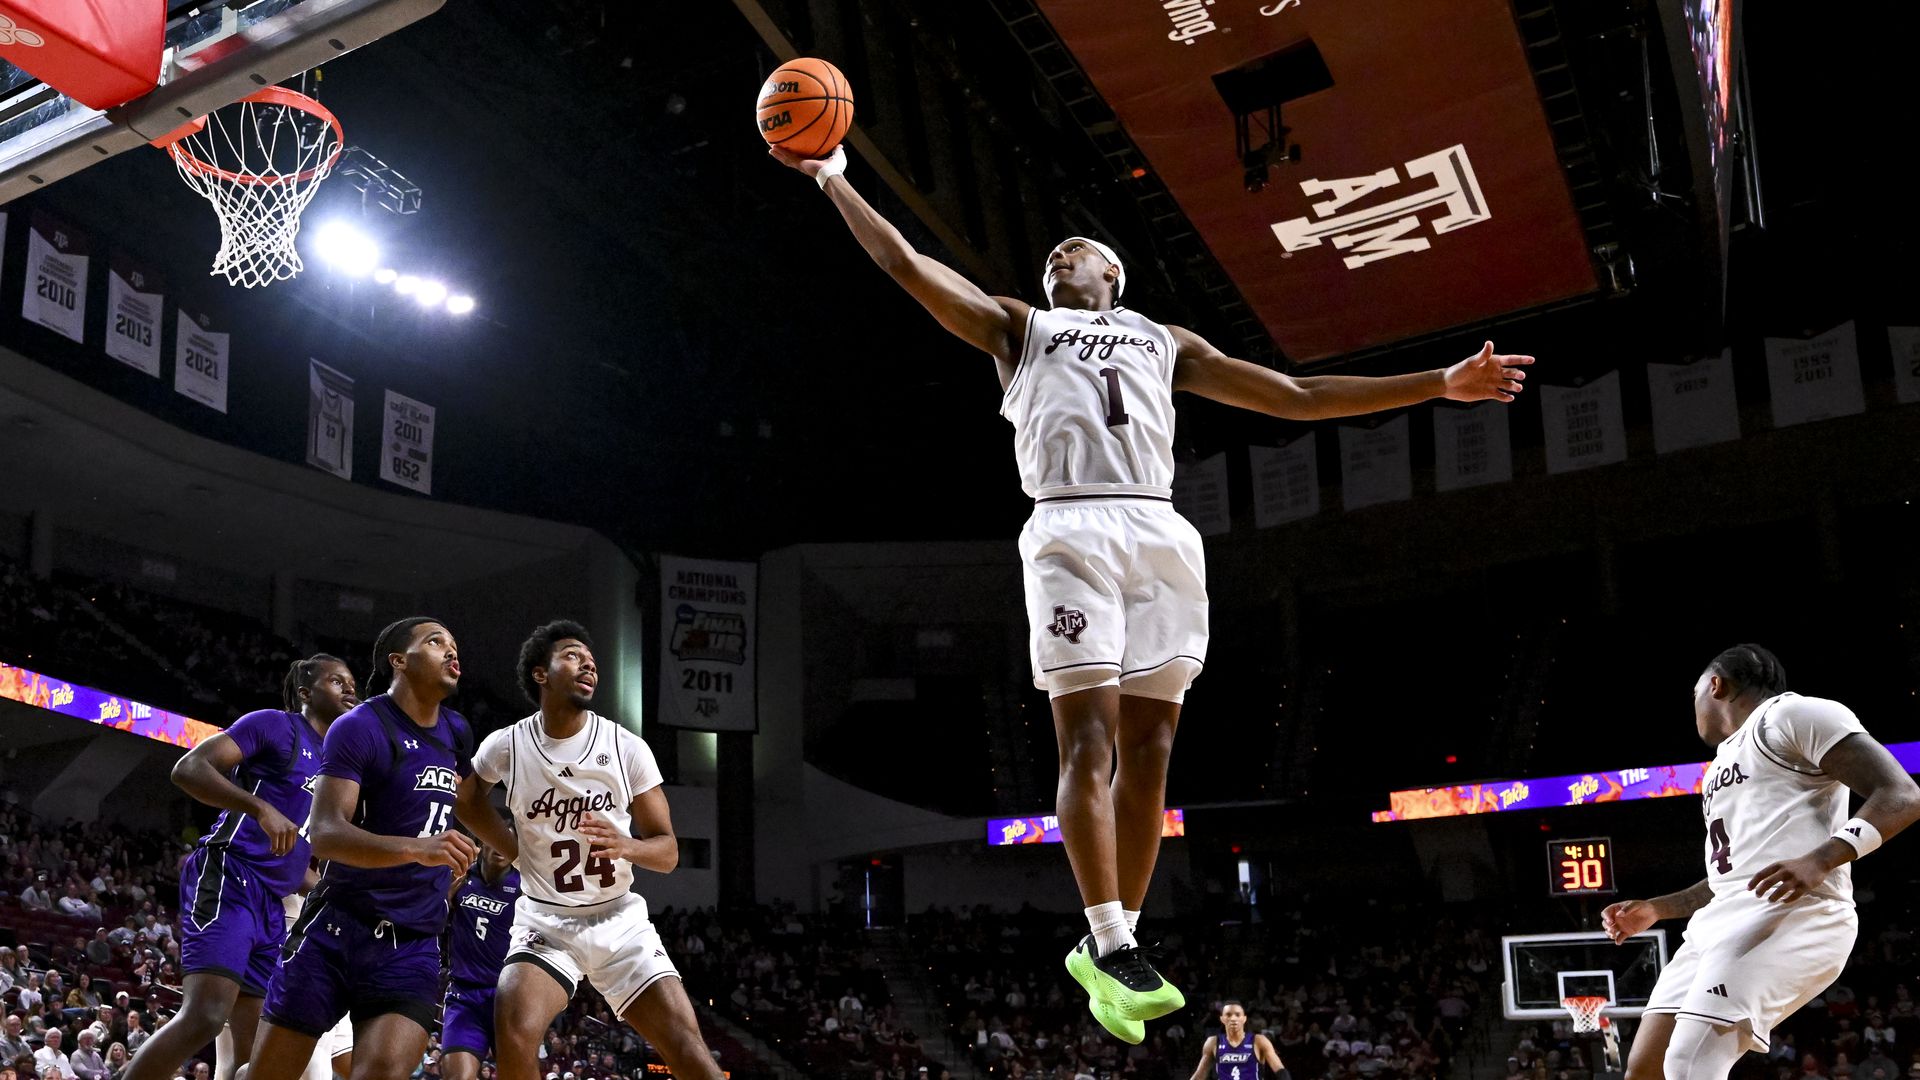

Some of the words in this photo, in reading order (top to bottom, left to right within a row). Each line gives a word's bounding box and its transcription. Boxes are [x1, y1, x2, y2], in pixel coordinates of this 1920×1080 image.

[760, 110, 792, 132] NCAA
[37, 275, 75, 310] 2010
[115, 314, 152, 347] 2013
[1045, 329, 1159, 361] Aggies
[185, 348, 219, 380] 2021
[1100, 368, 1129, 427] 1
[394, 420, 423, 445] 2011
[677, 571, 739, 589] NATIONAL
[668, 585, 747, 605] CHAMPIONS
[682, 668, 733, 693] 2011
[51, 686, 75, 709] Takis
[99, 700, 121, 720] Takis
[131, 701, 152, 720] THE
[1568, 777, 1599, 803] Takis
[1619, 767, 1650, 788] THE
[1704, 762, 1750, 817] gies
[1499, 783, 1529, 810] Takis
[417, 801, 453, 838] 15
[526, 787, 617, 833] Aggies
[1041, 815, 1059, 832] TH
[1564, 843, 1606, 860] 4:11
[1710, 818, 1733, 875] 4
[550, 838, 616, 893] 24
[1561, 859, 1603, 889] 30
[464, 895, 503, 913] ACU
[476, 916, 489, 941] 5
[1222, 1053, 1248, 1063] ACU
